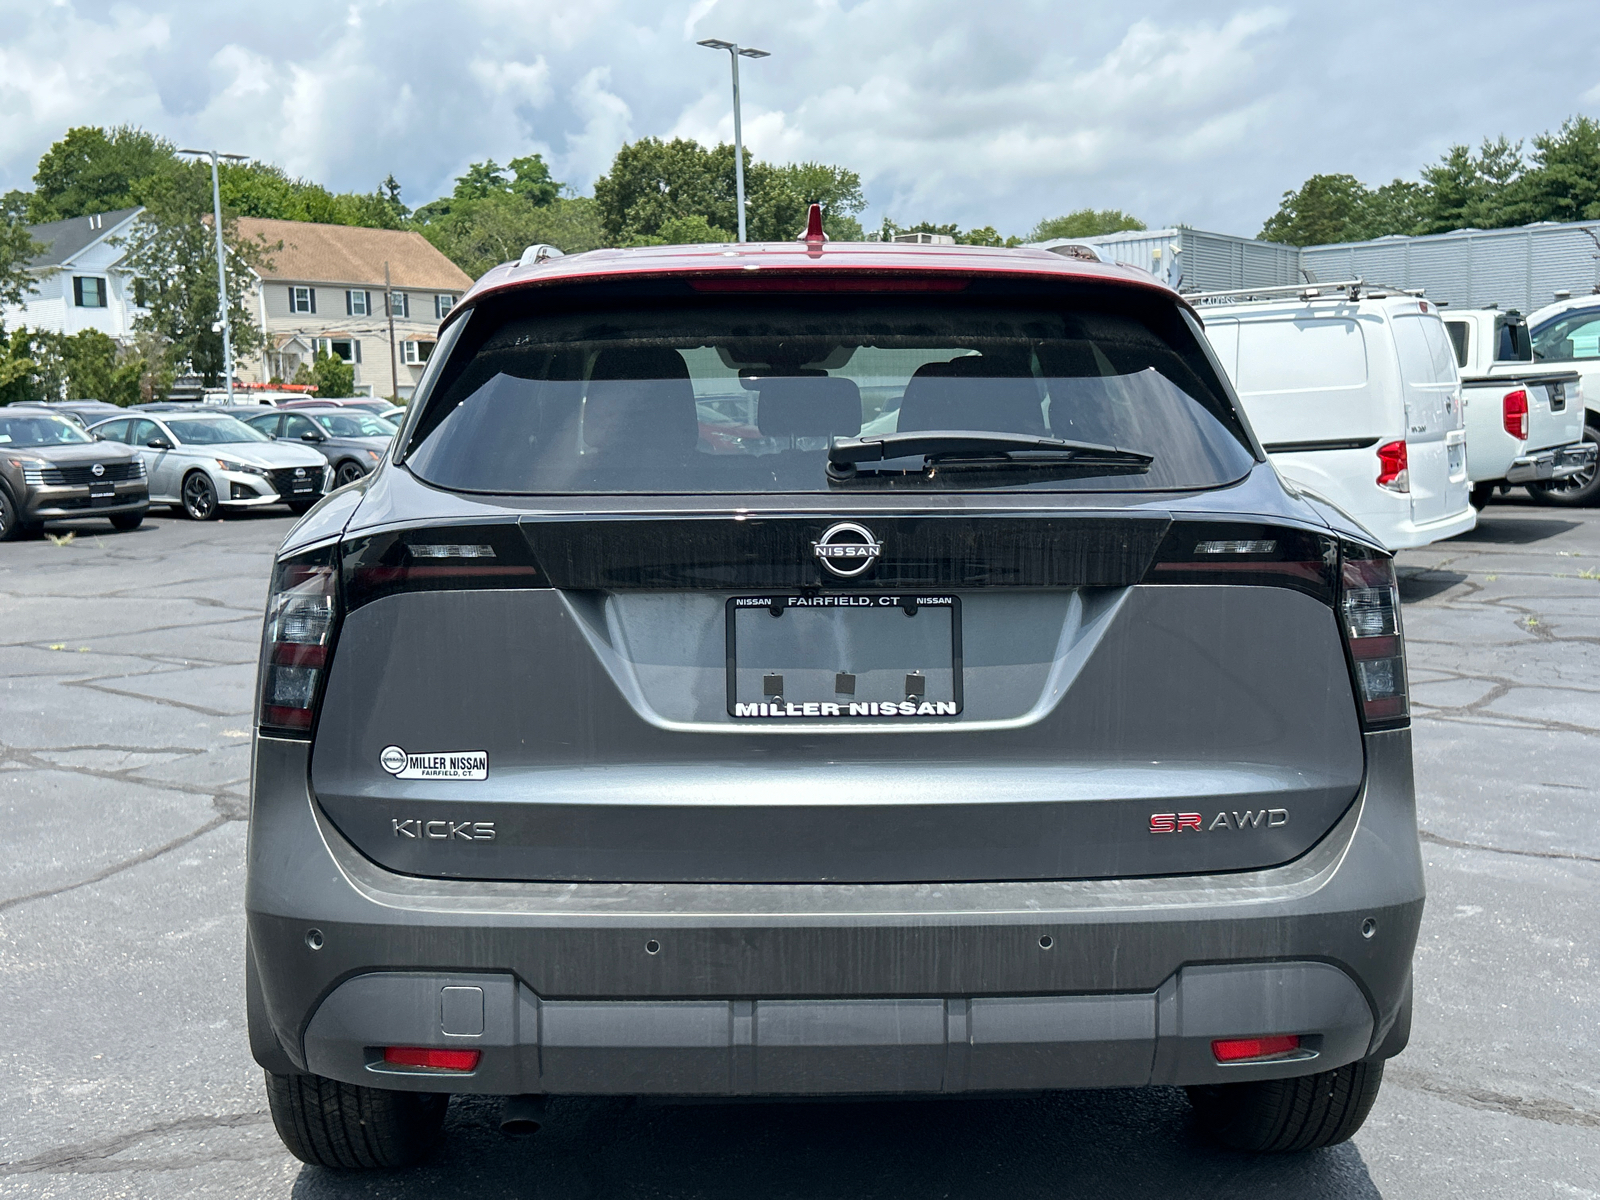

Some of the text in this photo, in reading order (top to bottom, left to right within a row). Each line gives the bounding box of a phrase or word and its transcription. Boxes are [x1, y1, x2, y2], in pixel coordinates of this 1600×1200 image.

[815, 546, 880, 557] NISSAN
[736, 598, 772, 606] NISSAN
[788, 596, 900, 607] FAIRFIELD, CT
[916, 597, 952, 605] NISSAN
[735, 701, 956, 717] MILLER NISSAN
[409, 756, 486, 770] MILLER NISSAN
[1149, 808, 1290, 834] SR AWD
[391, 818, 496, 841] KICKS
